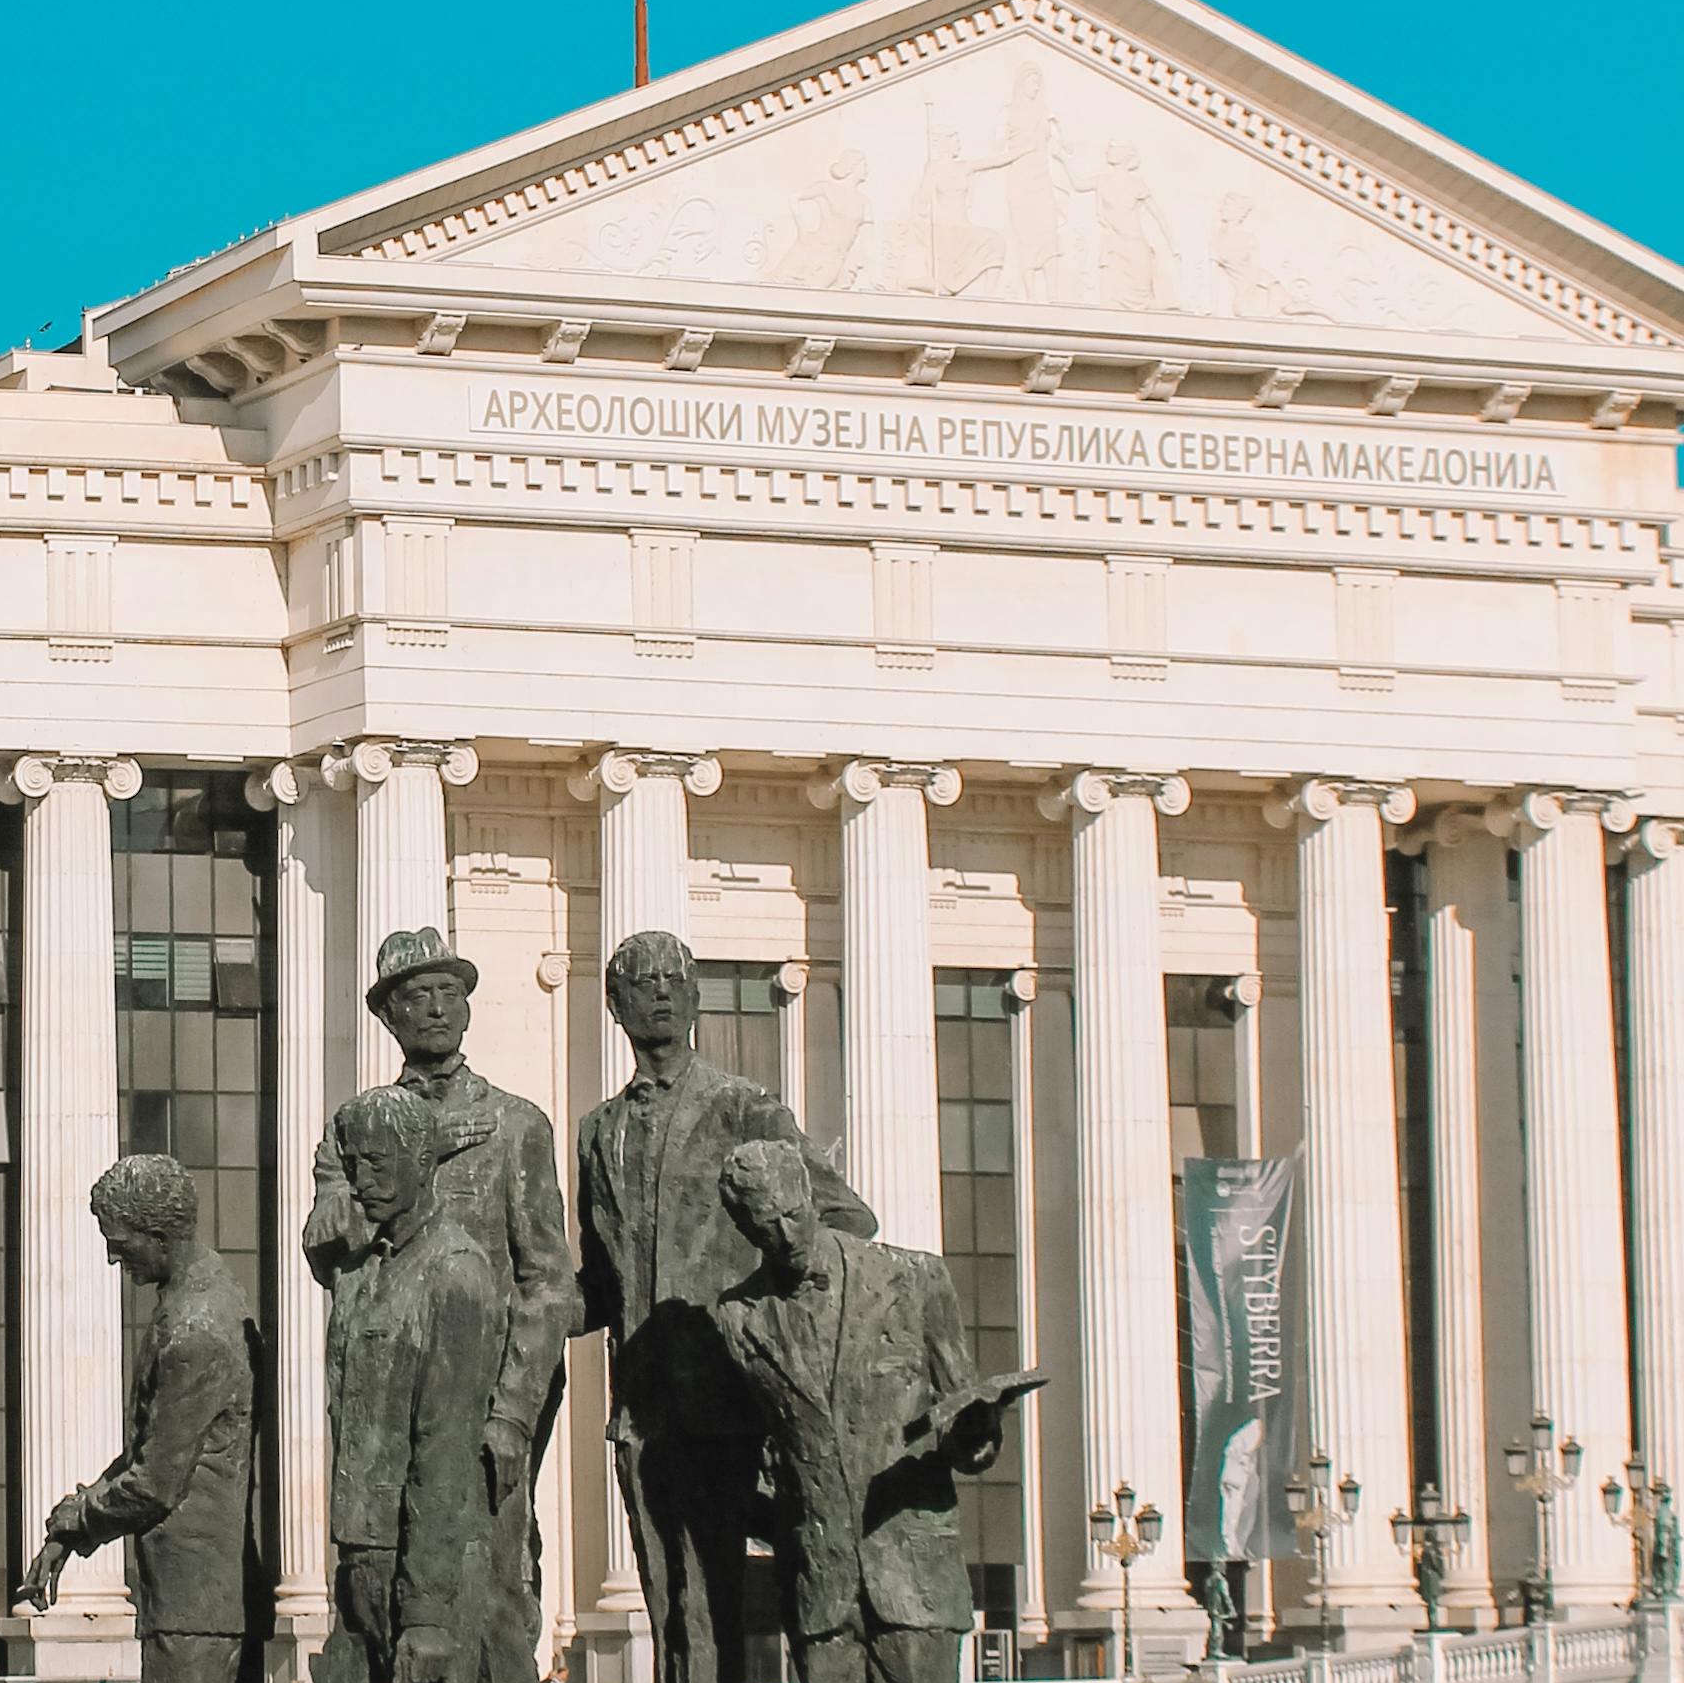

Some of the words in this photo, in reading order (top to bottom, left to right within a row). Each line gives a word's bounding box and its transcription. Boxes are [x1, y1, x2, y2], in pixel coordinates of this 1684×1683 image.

[482, 388, 743, 442] АРХЕОЛОШКИ
[756, 403, 868, 451] МУЗЕЈ
[879, 412, 935, 454] НА
[937, 416, 1151, 468] РЕПУБЛИКА
[1157, 429, 1314, 478] СЕВЕРНА
[1321, 440, 1558, 492] МАКЕДОНИЈА
[1239, 1225, 1282, 1404] STYBERRA
